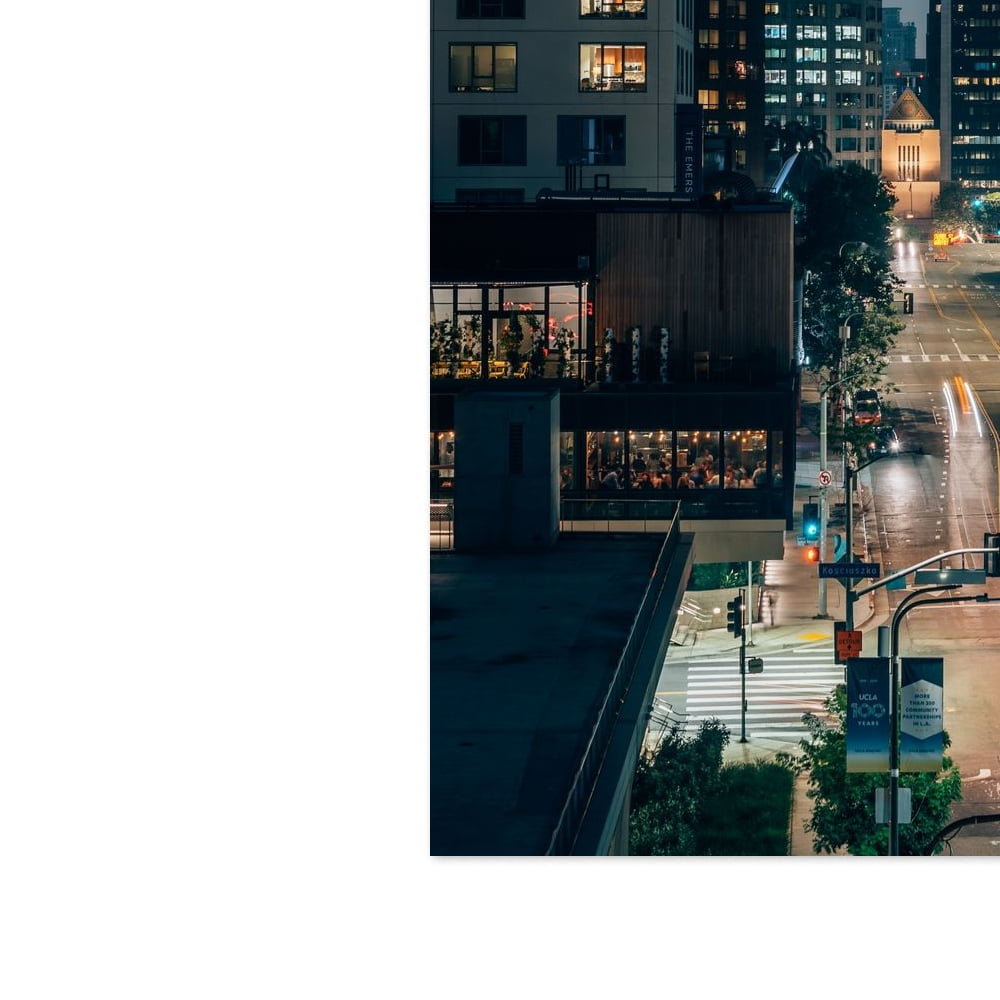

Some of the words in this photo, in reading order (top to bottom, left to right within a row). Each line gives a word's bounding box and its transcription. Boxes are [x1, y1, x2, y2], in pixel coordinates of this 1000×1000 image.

[685, 131, 693, 152] THE
[685, 156, 693, 193] EMERS
[858, 693, 878, 701] UCLA
[850, 702, 887, 719] 100
